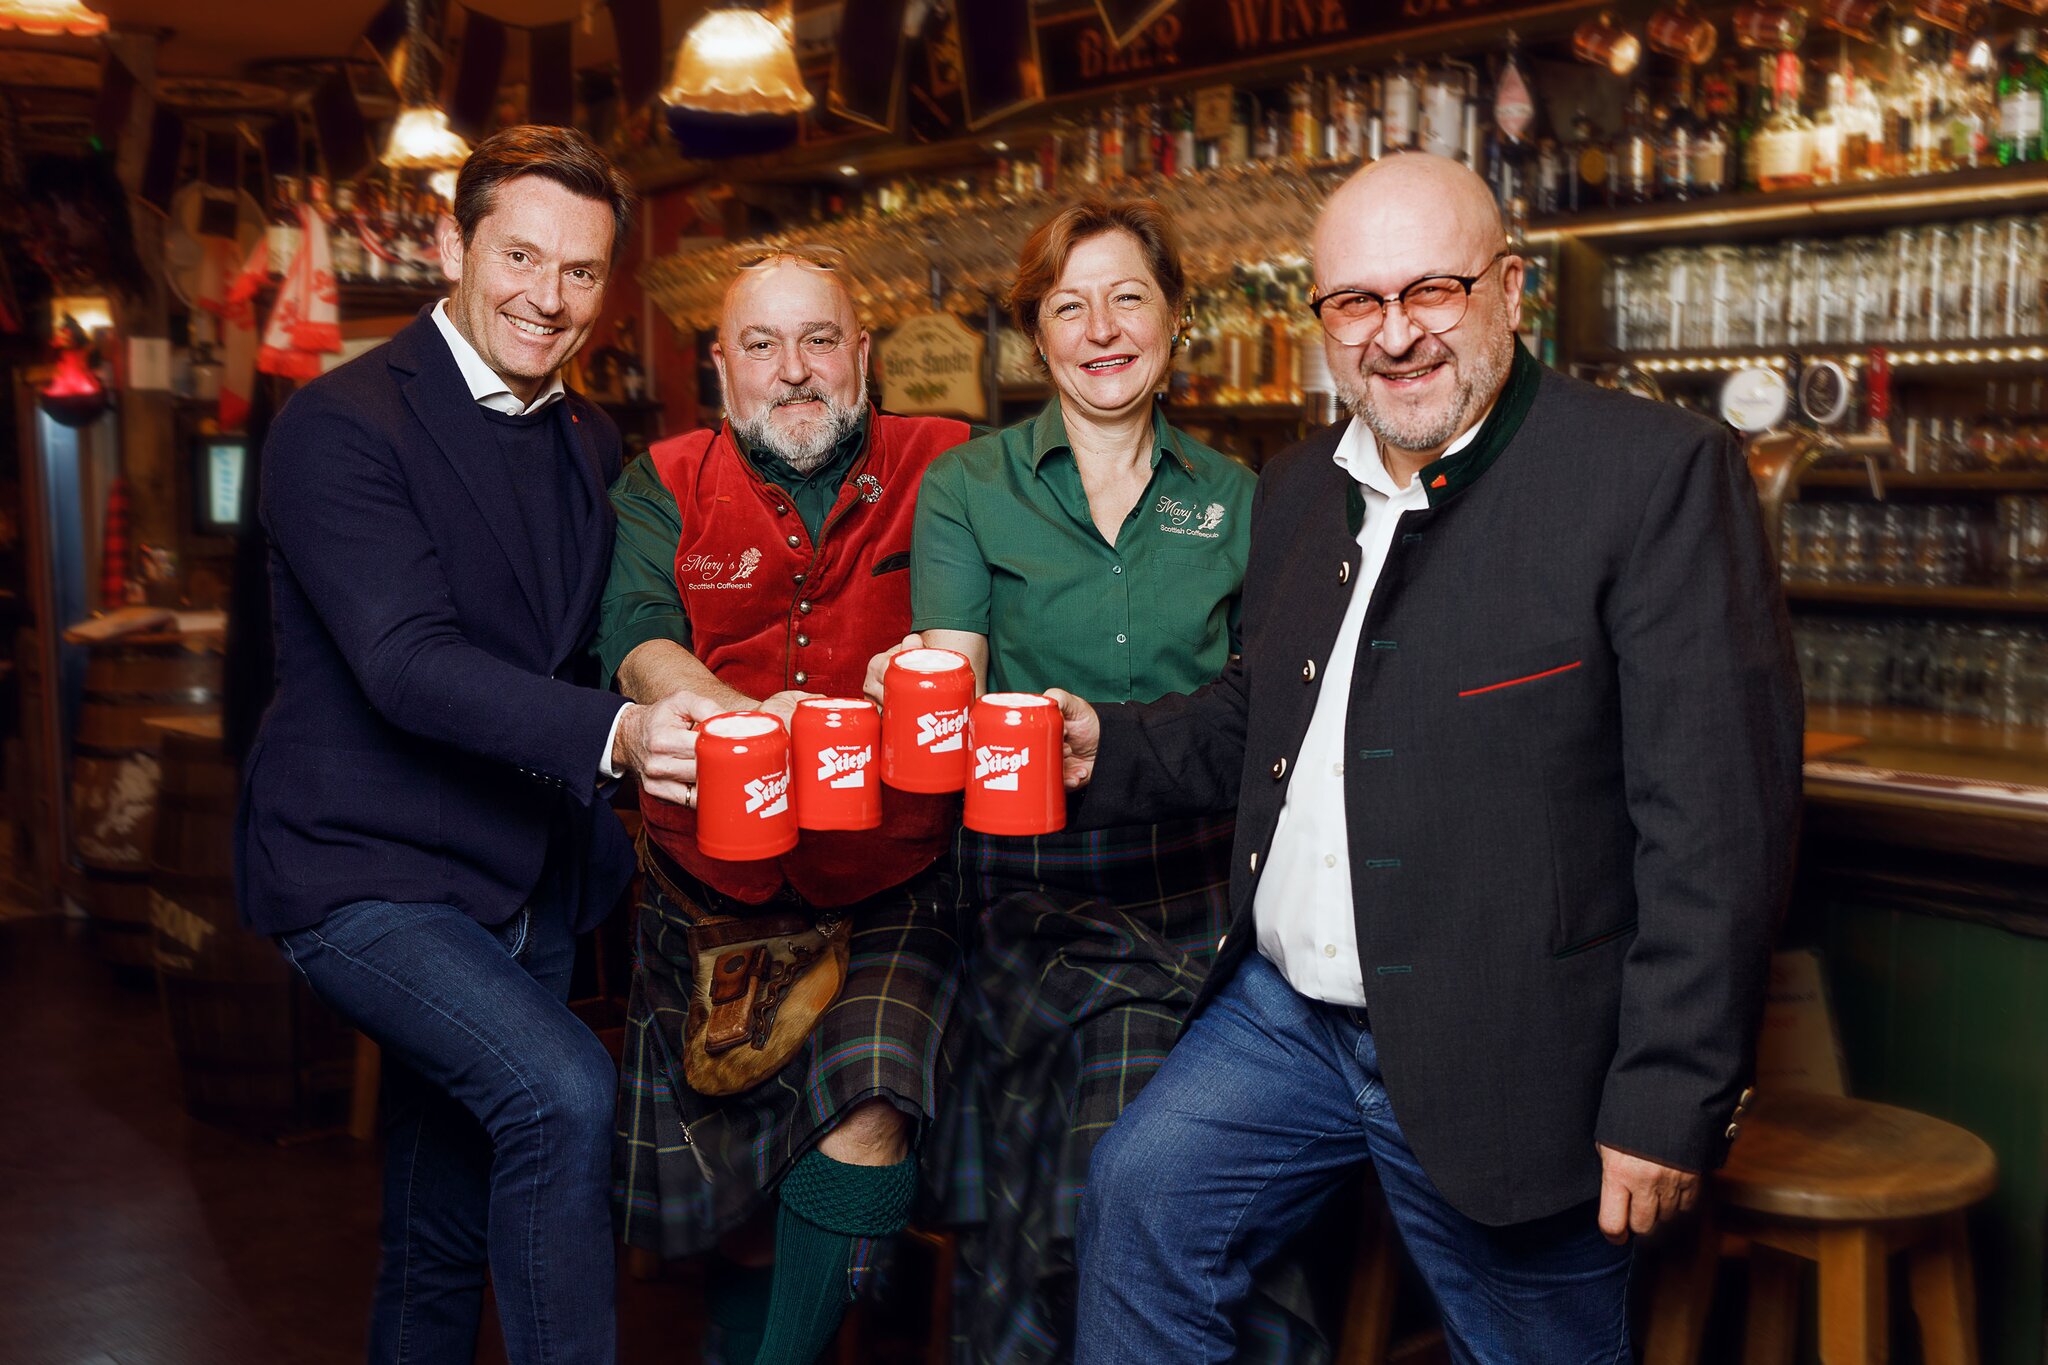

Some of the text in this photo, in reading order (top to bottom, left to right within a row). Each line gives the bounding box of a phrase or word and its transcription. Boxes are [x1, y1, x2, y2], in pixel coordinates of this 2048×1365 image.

[1160, 524, 1185, 535] Scottish
[688, 582, 753, 590] Scottish Coffeepub
[916, 705, 969, 746] Stiegl
[817, 744, 872, 781] Stiegl
[974, 745, 1030, 780] Stiegl
[743, 772, 791, 814] Stiegl
